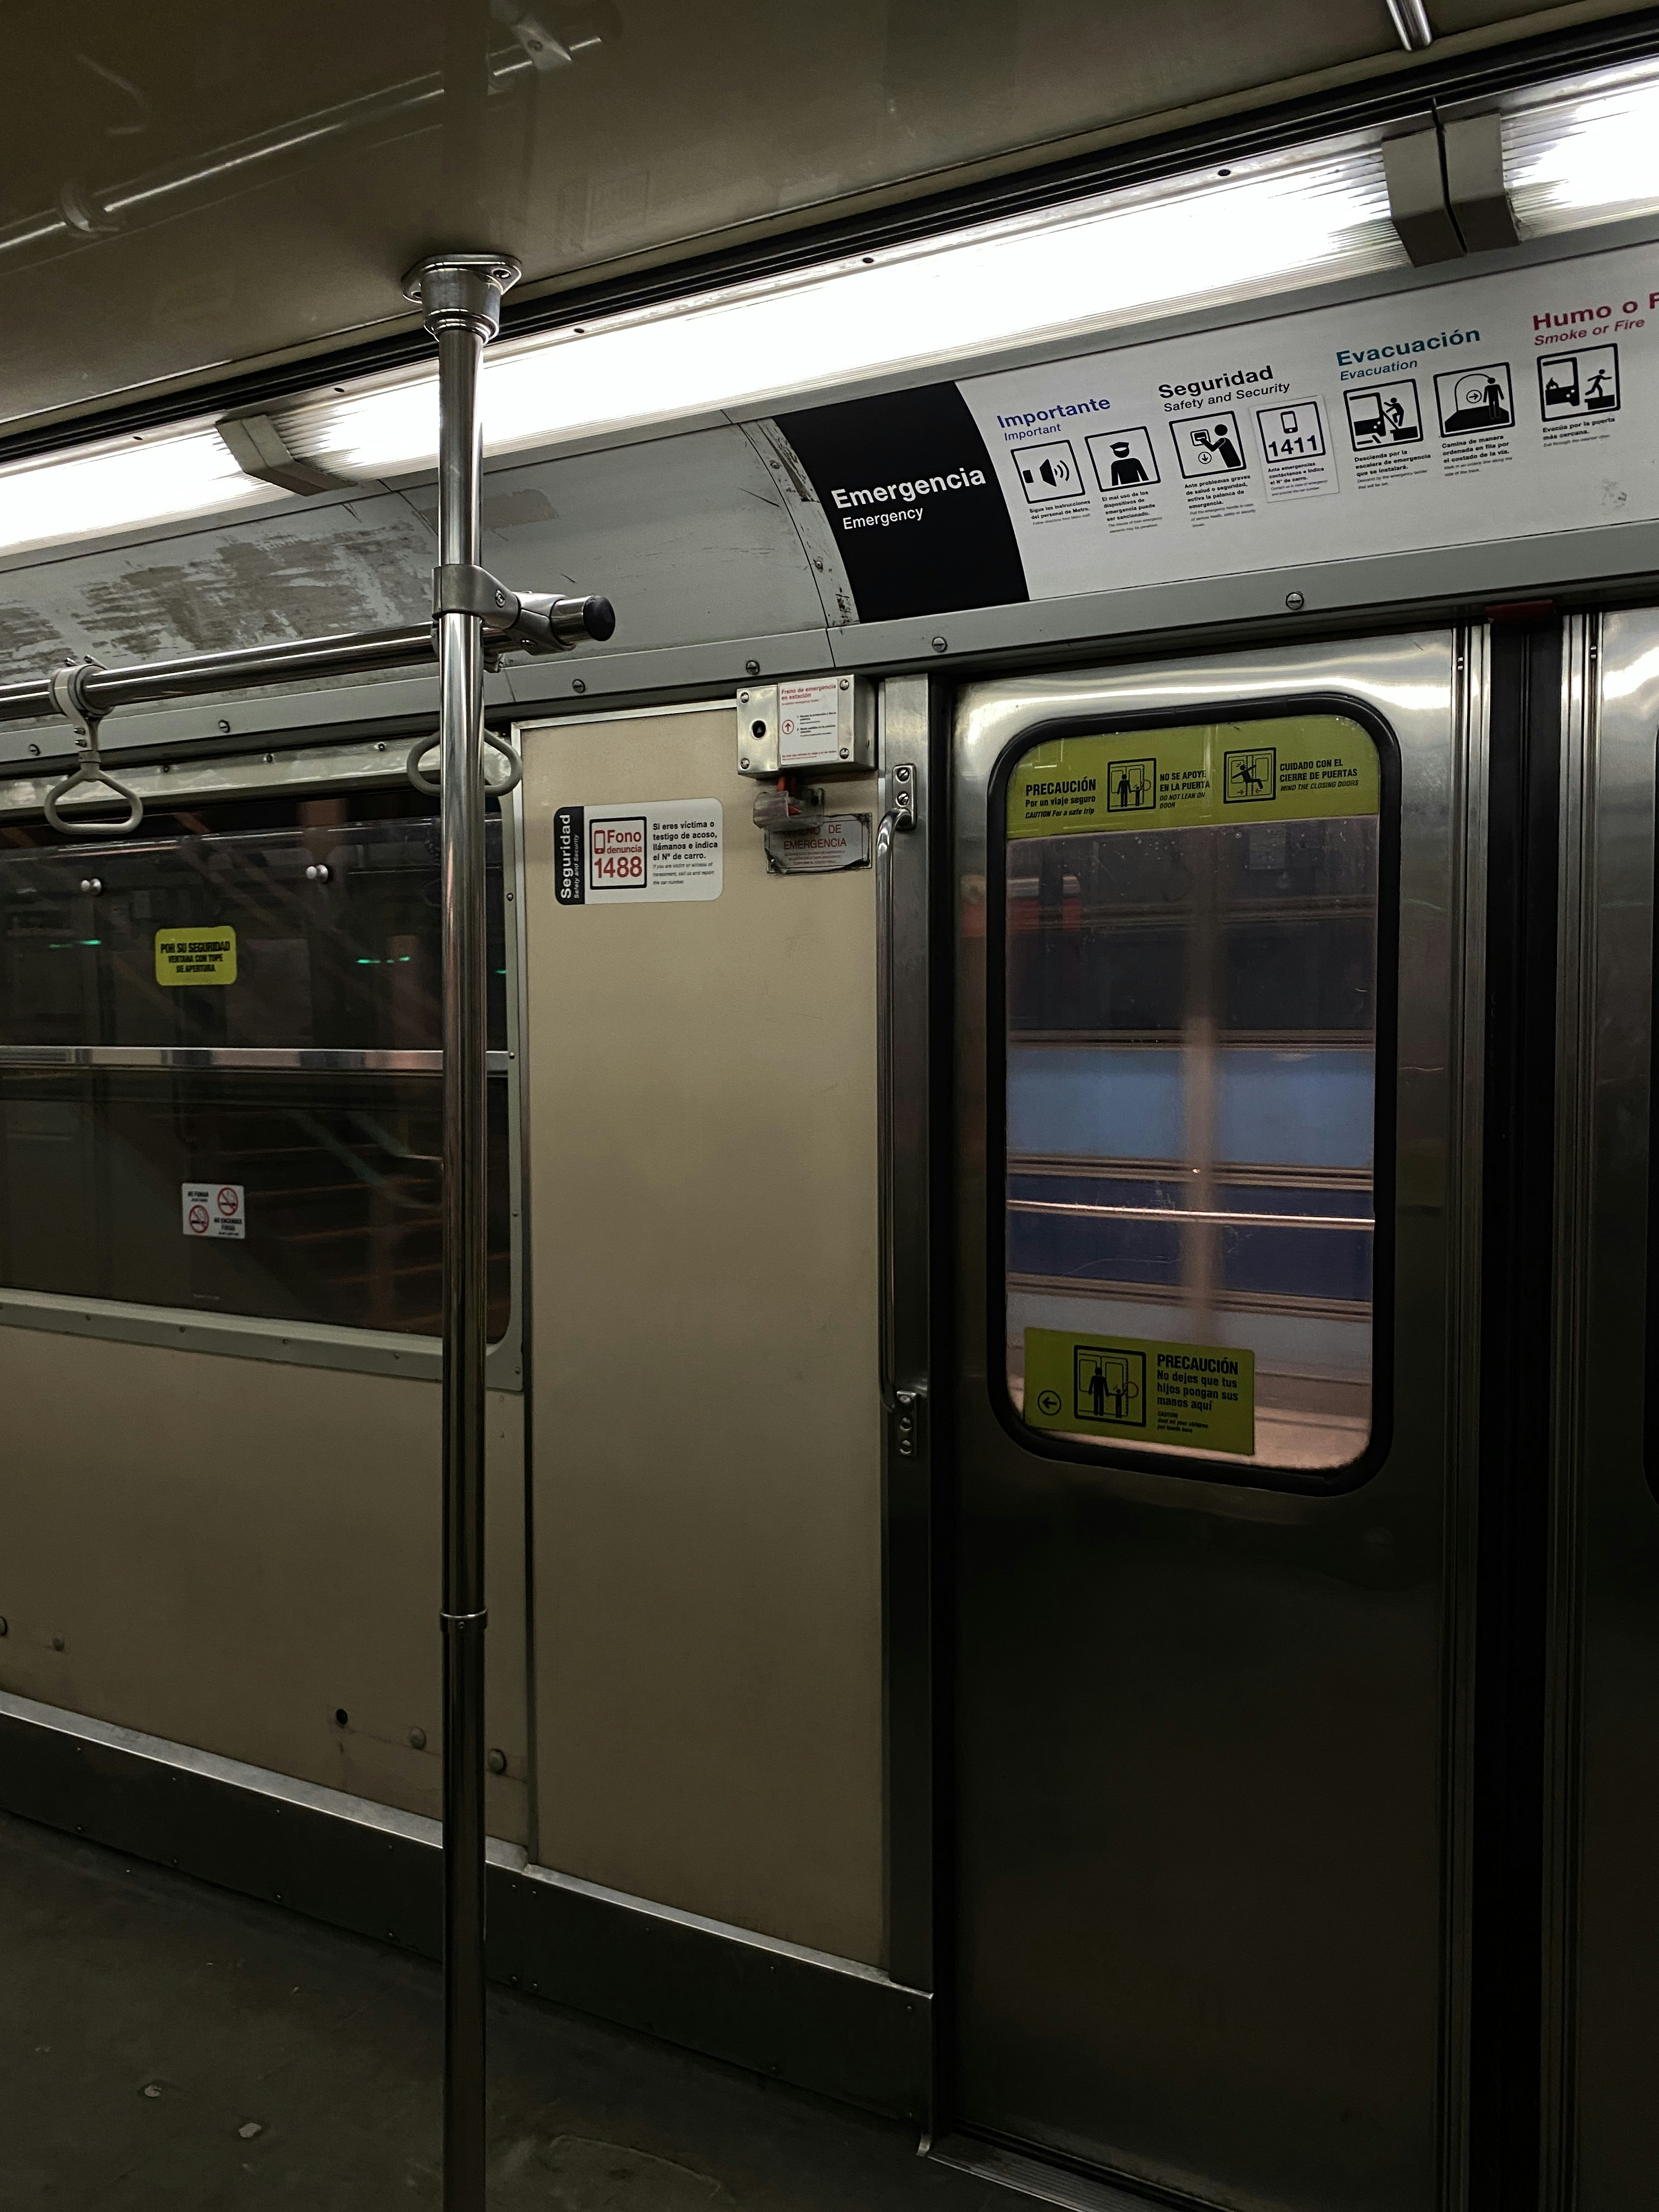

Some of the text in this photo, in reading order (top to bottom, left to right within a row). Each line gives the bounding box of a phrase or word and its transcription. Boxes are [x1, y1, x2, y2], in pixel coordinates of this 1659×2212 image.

[1533, 301, 1638, 330] Humo o
[1534, 319, 1645, 346] Smoke or Fire
[1336, 329, 1480, 366] Evacuación
[1341, 360, 1417, 380] Evacuation
[1159, 365, 1273, 398] Seguridad
[1164, 383, 1290, 412] Safety and Security
[997, 399, 1110, 428] Importante
[1592, 417, 1615, 426] puerta
[1005, 424, 1061, 441] Important
[1559, 430, 1589, 438] cercana.
[1268, 435, 1317, 456] 1411
[1443, 447, 1474, 456] ordenada
[1355, 453, 1387, 462] Descienda
[1393, 454, 1431, 463] emergencia
[1282, 462, 1316, 471] emergencias
[1379, 464, 1408, 473] instalará.
[831, 467, 986, 509] Emergencia
[1199, 478, 1229, 487] problemas
[1217, 482, 1248, 490] seguridad.
[1054, 500, 1091, 509] instrucciones
[1104, 499, 1136, 508] dispositivos
[1189, 500, 1224, 509] emergencia.
[1041, 511, 1063, 519] personal
[1105, 506, 1137, 515] emergencia
[843, 509, 924, 531] Emergency
[1280, 759, 1343, 771] CUIDADO CON EL
[1160, 770, 1206, 781] NO SE APOYE
[1280, 768, 1358, 782] CIERRE DE PUERTAS
[1025, 776, 1096, 796] PRECAUCIÓN
[1182, 781, 1210, 790] PUERTA
[1310, 781, 1336, 789] CLOSING
[1051, 797, 1068, 806] viaje
[1070, 795, 1096, 805] seguro
[1025, 810, 1051, 819] CAUTION
[680, 821, 707, 829] víctima
[828, 825, 842, 833] DE
[607, 829, 642, 843] Fono
[653, 833, 678, 841] testigo
[606, 844, 642, 854] denuncia
[783, 838, 847, 850] EMERGENCIA
[559, 814, 574, 899] Seguridad
[594, 855, 642, 878] 1488
[160, 941, 230, 953] POR SU SEGURIDAD
[1157, 1353, 1238, 1375] PRECAUCIÓN
[1157, 1370, 1237, 1388] No dejes que tus
[1157, 1382, 1238, 1401] hijos pongan sus
[1157, 1397, 1213, 1412] manos aquí
